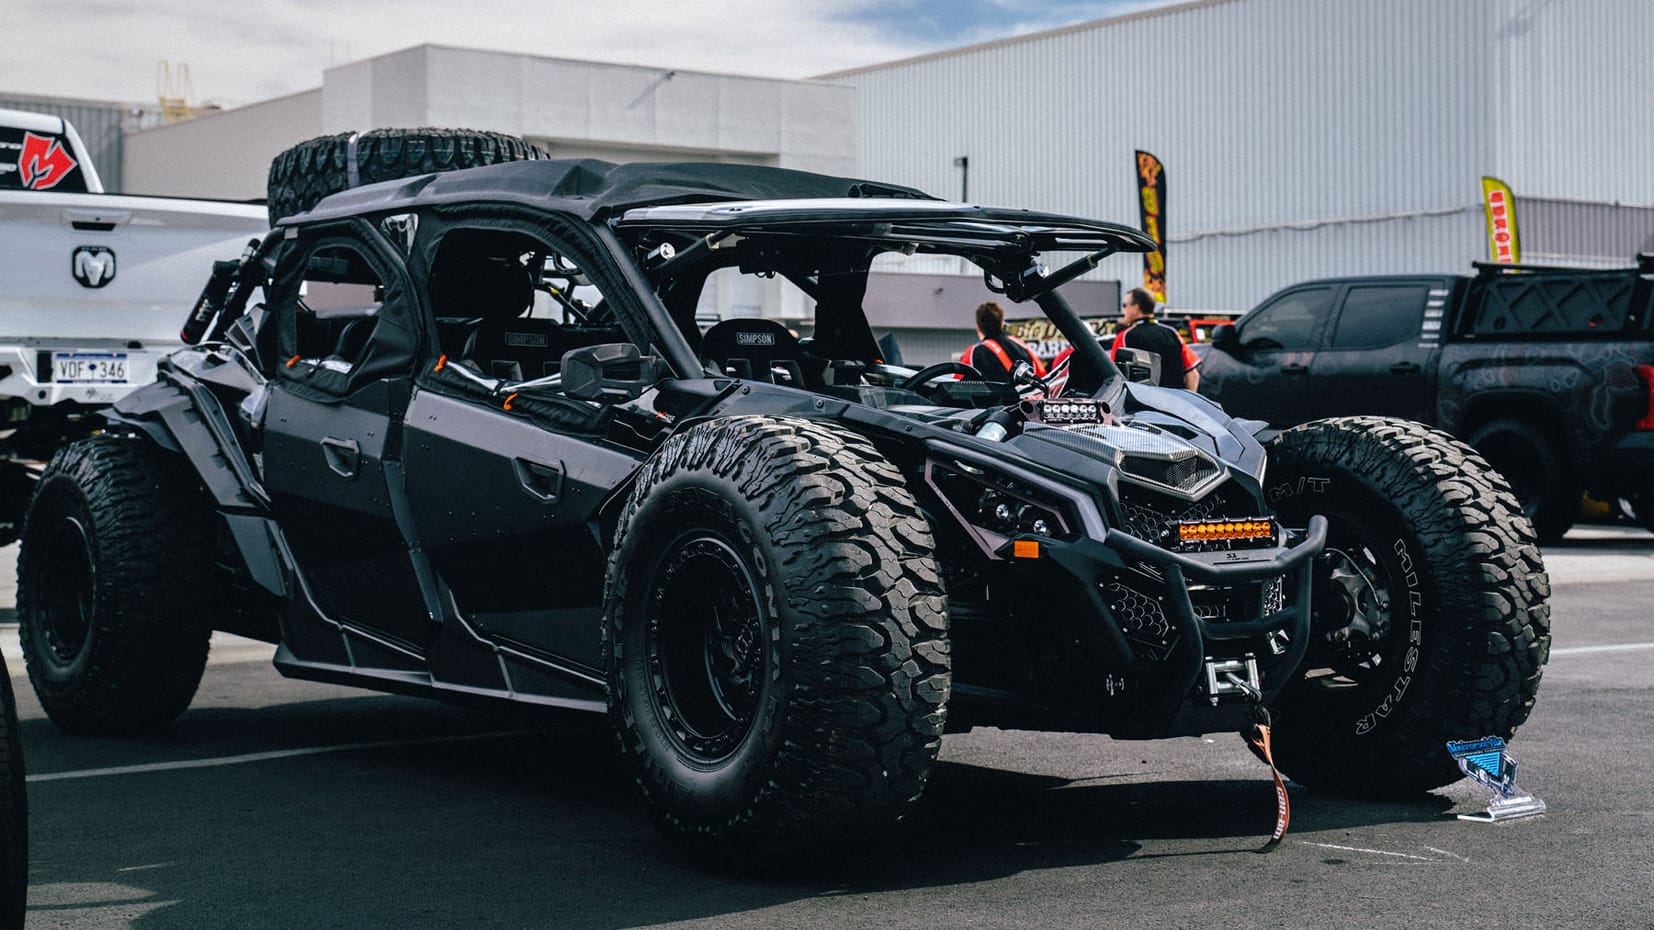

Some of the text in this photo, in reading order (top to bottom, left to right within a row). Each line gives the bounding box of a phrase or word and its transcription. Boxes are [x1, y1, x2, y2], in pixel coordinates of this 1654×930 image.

[738, 333, 773, 345] SIMPSON
[100, 361, 125, 378] 346
[1269, 477, 1331, 502] M/T
[1356, 538, 1422, 735] MILESTAR
